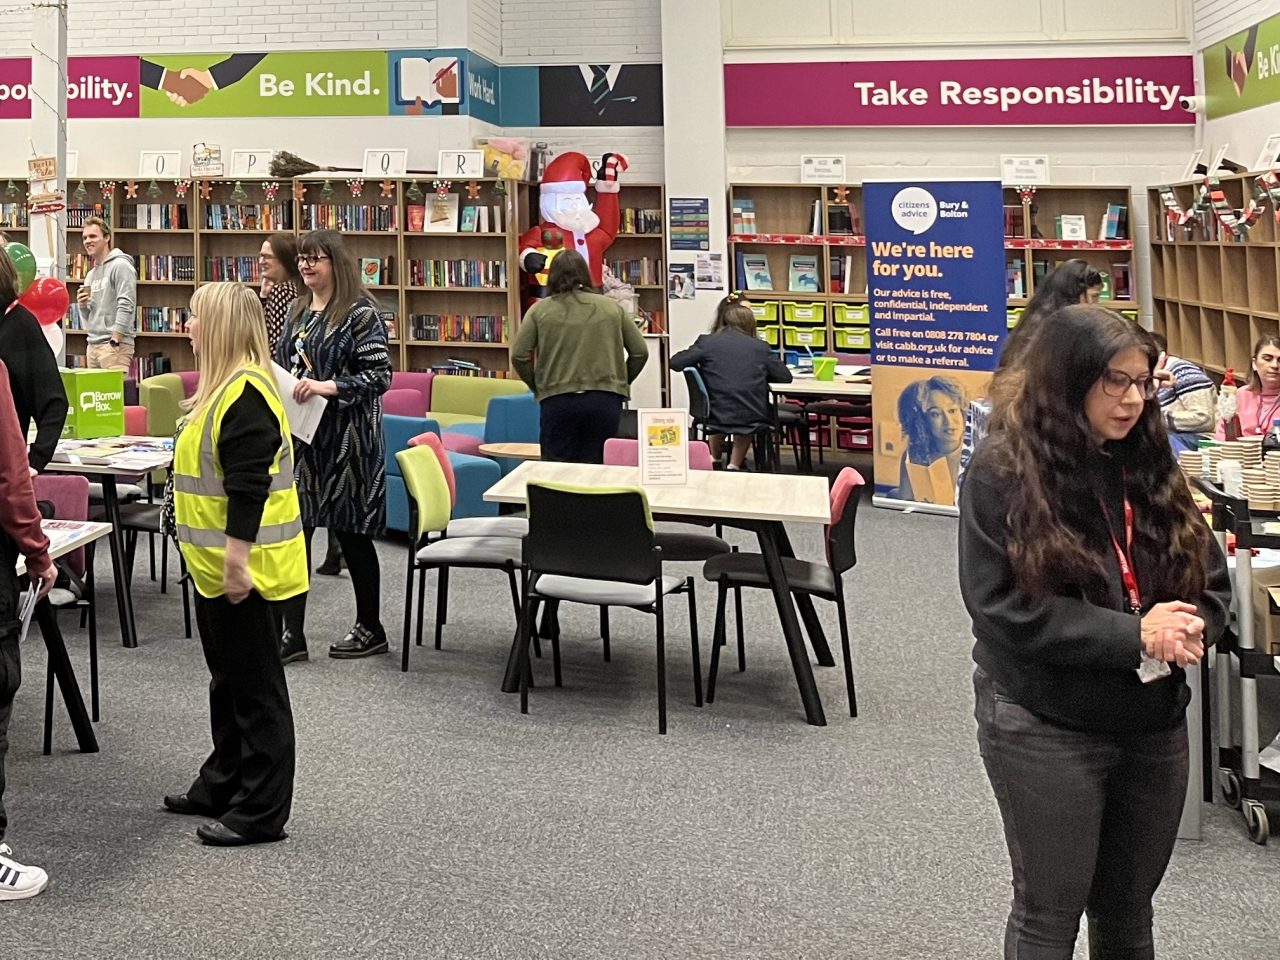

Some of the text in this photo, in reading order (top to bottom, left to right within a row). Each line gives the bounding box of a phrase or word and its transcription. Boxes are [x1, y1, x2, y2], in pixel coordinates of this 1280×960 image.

[1257, 51, 1269, 80] Be
[259, 71, 380, 97] Be Kind.
[854, 77, 1187, 111] Take Responsibility.
[247, 154, 257, 174] P
[380, 153, 390, 175] Q
[455, 154, 466, 175] R
[939, 201, 969, 211] Bury &
[901, 210, 928, 218] advice
[940, 210, 968, 218] Bolton
[872, 241, 974, 259] We're here
[872, 260, 943, 281] for you.
[873, 288, 952, 300] Our advice is free,
[874, 300, 988, 313] confidential, independent
[874, 311, 936, 322] and impartial.
[875, 328, 891, 337] Call
[892, 328, 911, 338] free
[925, 330, 946, 339] 0808
[948, 331, 963, 340] 278
[965, 332, 987, 341] 7804
[988, 334, 998, 342] or
[875, 341, 994, 355] visit cabb.org.uk for advice
[876, 354, 886, 362] or
[887, 354, 897, 362] to
[898, 355, 924, 364] make
[932, 358, 969, 367] referral.
[95, 391, 122, 401] Borrow
